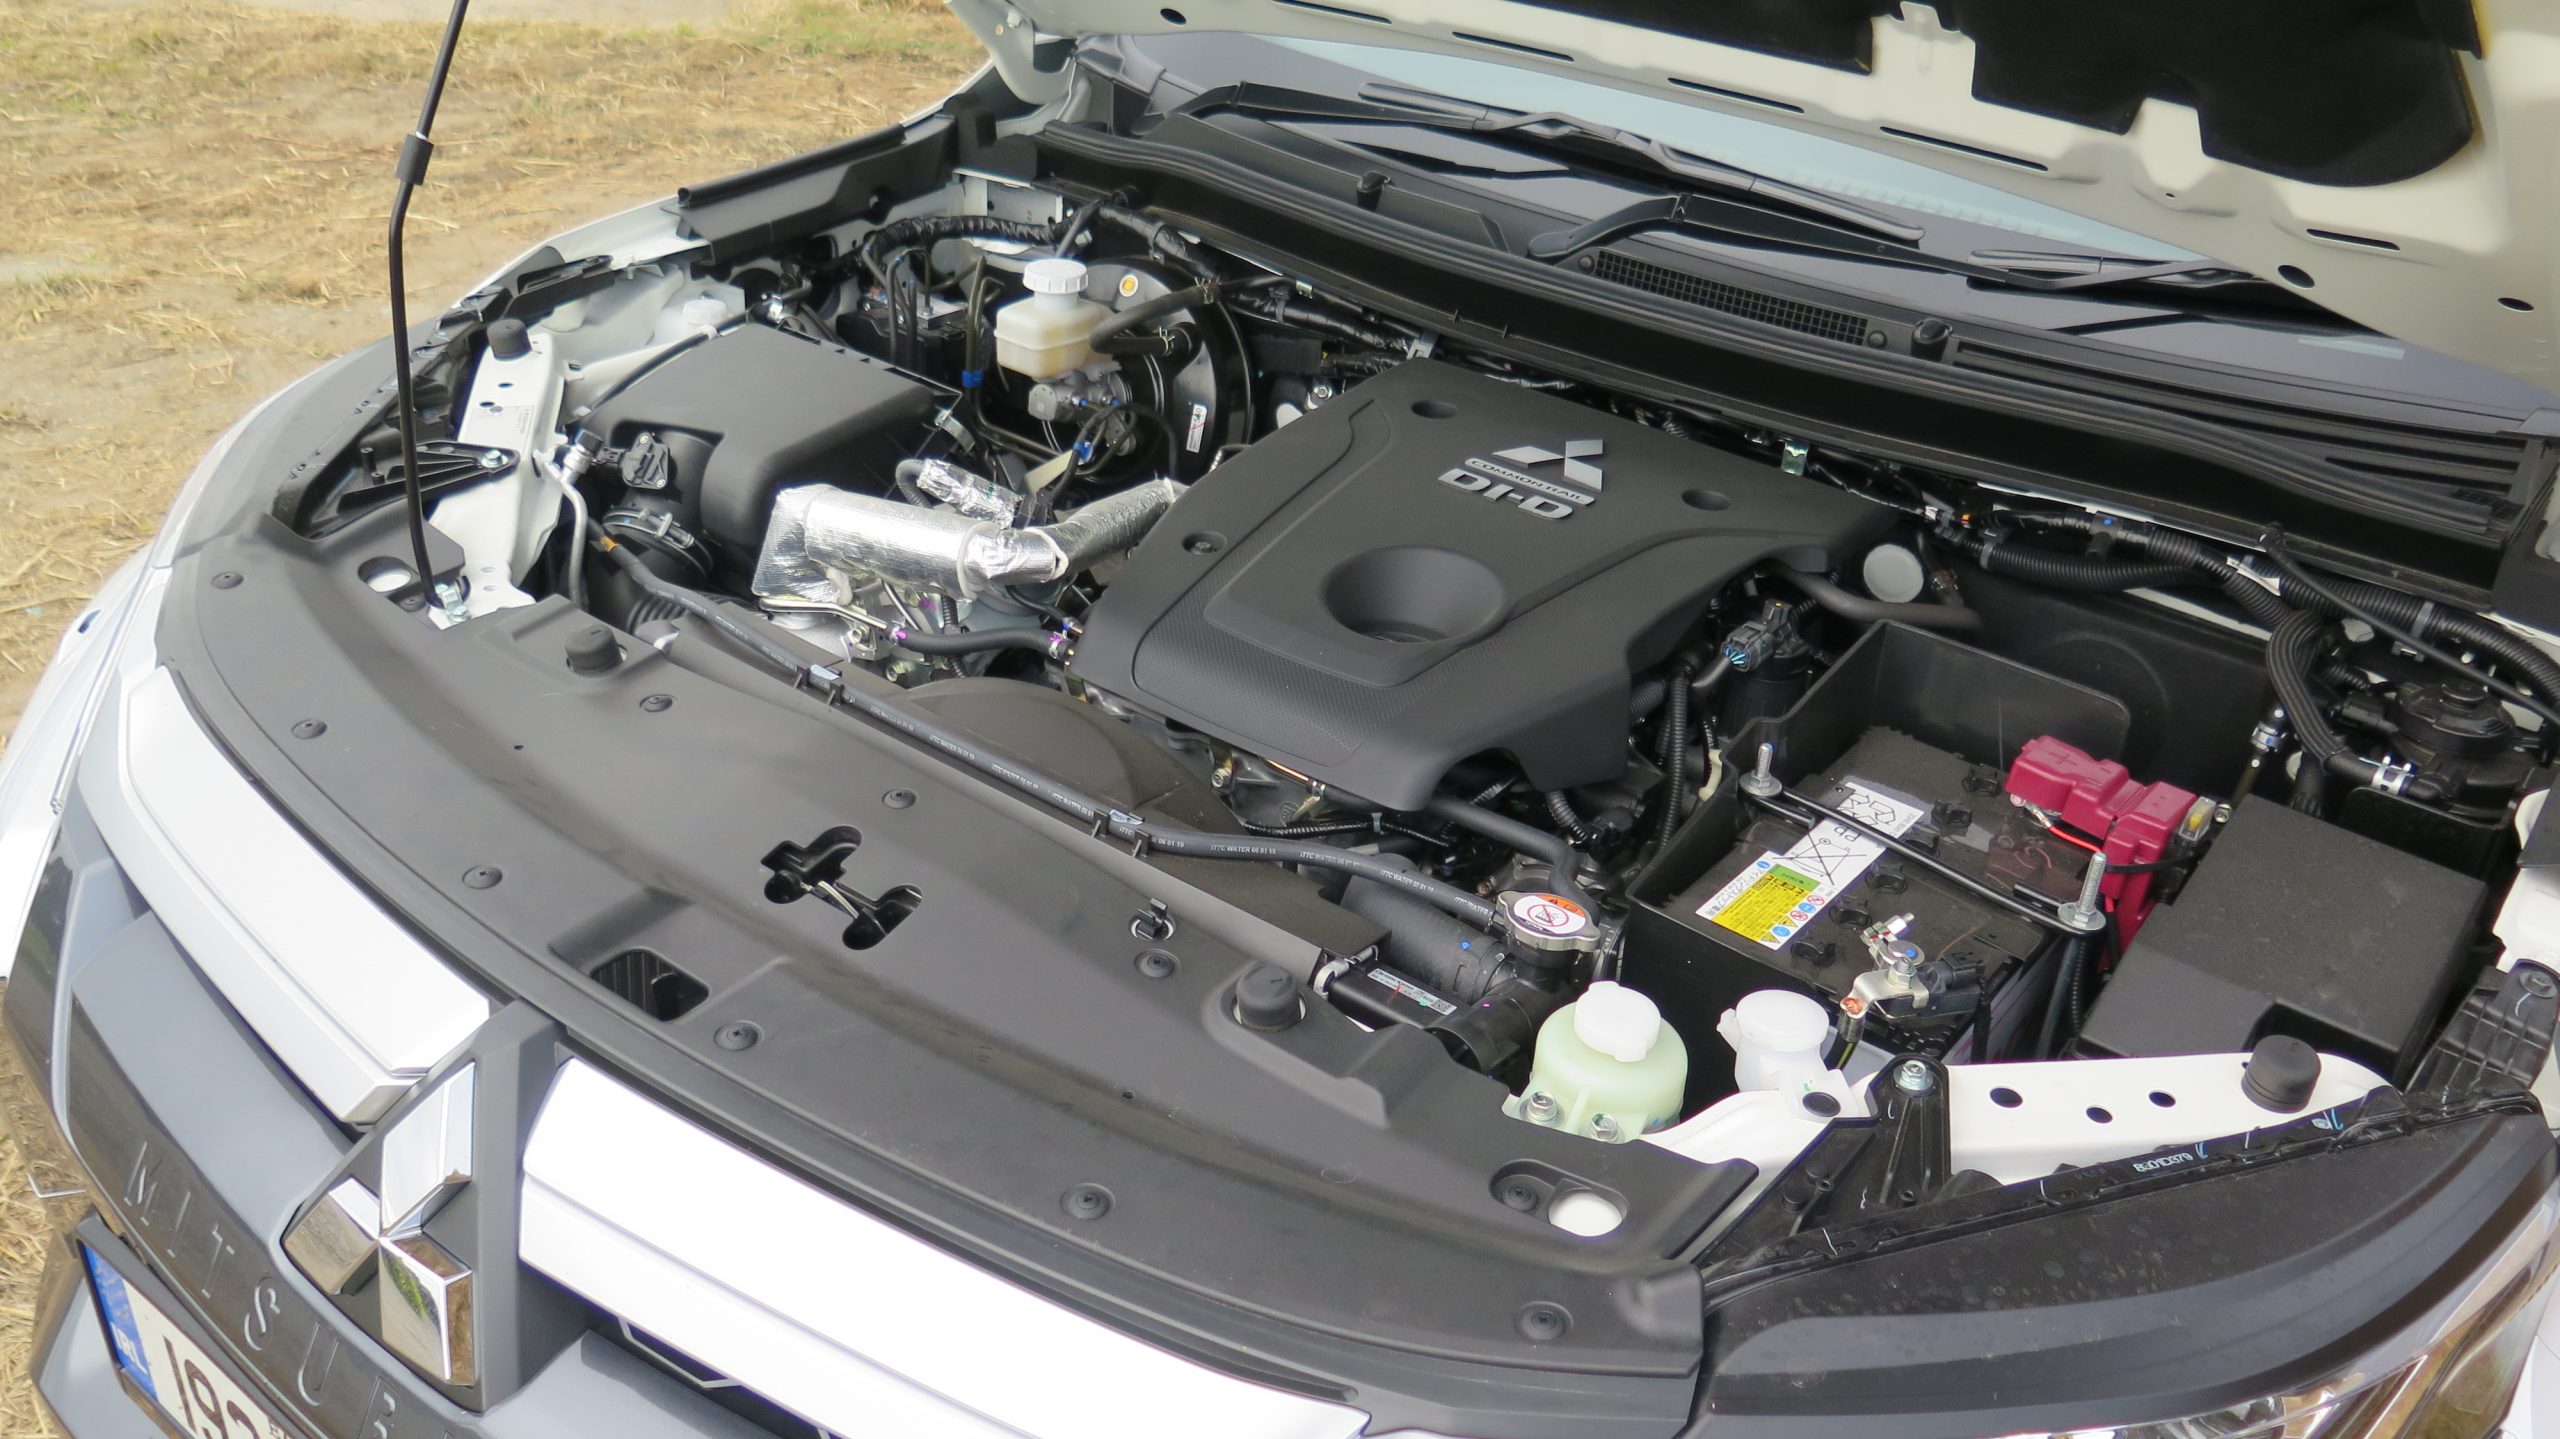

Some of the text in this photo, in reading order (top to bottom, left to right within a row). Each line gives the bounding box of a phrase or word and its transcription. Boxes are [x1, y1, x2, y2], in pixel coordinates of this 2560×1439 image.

[1437, 468, 1573, 519] DI-D
[1471, 460, 1584, 500] COMMON RAIL
[1226, 845, 1250, 853] WATER
[123, 1140, 456, 1439] MITSUB
